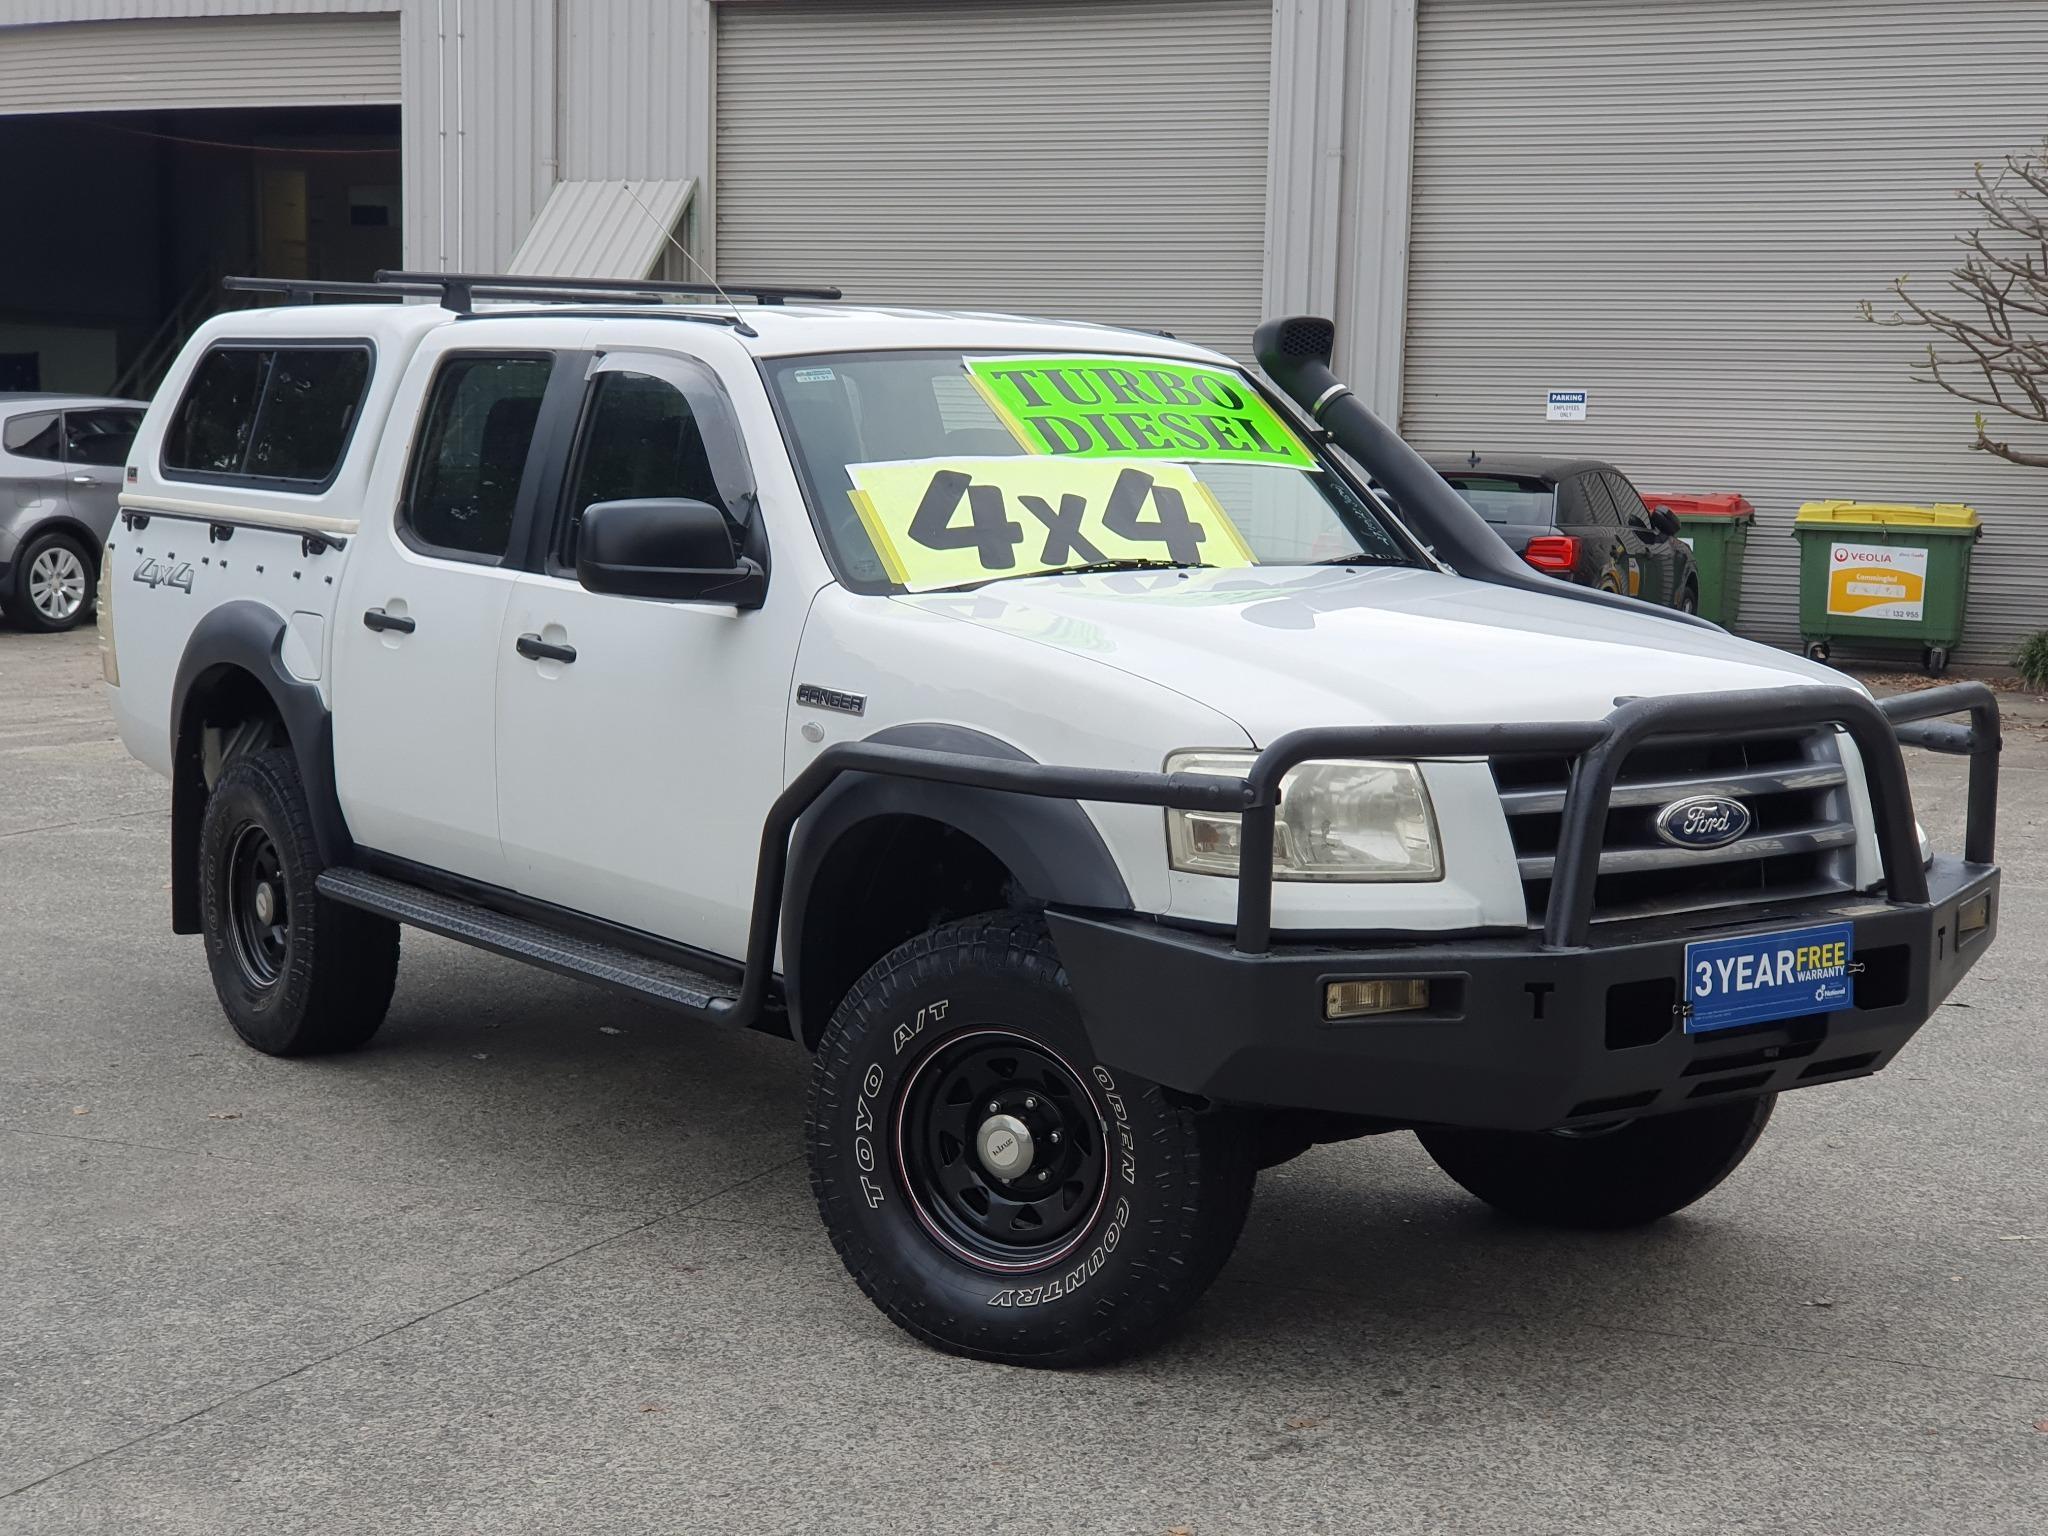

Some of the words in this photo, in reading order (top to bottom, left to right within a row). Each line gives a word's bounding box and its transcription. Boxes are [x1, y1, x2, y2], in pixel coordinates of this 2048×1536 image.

[994, 368, 1244, 411] TURBO
[1024, 412, 1290, 457] DIESEL
[908, 468, 1206, 569] 4x4
[133, 557, 194, 594] 4x4
[1851, 552, 1892, 563] VEOLIA
[799, 688, 864, 712] RANGER
[1683, 805, 1731, 835] Ford
[1695, 960, 1713, 997] 3
[1716, 949, 1795, 994] YEAR
[1796, 942, 1845, 971] FREE
[1797, 966, 1845, 983] WARRANTY
[893, 1000, 949, 1055] A/T
[855, 1062, 884, 1209] TOYO
[1092, 1064, 1136, 1185] OPEN
[988, 1197, 1131, 1308] COUNTRY
